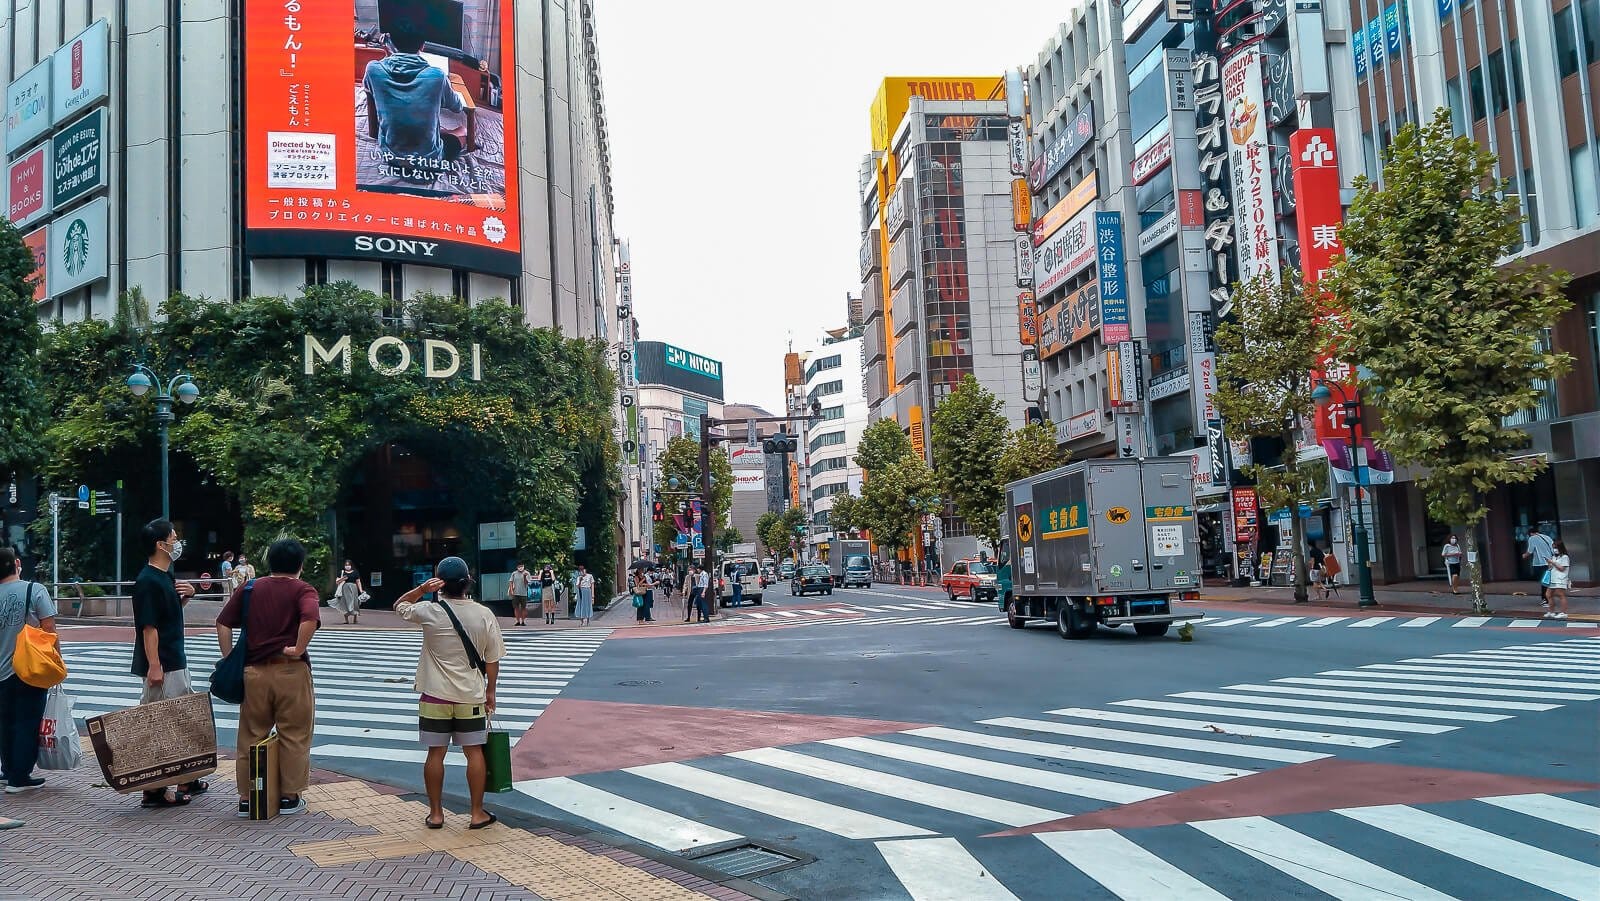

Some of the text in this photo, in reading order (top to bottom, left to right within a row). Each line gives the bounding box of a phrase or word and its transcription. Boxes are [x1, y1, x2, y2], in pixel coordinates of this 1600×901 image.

[1224, 54, 1254, 80] SHIBUYA
[1175, 73, 1186, 108] 山本事務所
[1225, 68, 1247, 92] HONEY
[1226, 82, 1245, 102] TOAST
[305, 142, 315, 150] by
[55, 139, 99, 179] じぶんdeエステ
[370, 151, 470, 175] いやーそれは良いよ
[17, 166, 36, 183] HMV
[23, 184, 29, 192] &
[11, 191, 41, 214] BOOKS
[268, 196, 351, 209] 一般投稿から
[269, 210, 478, 237] プロのクリエイターに選ばれた作品
[355, 236, 439, 257] SONY
[1099, 228, 1119, 295] 渋谷整形
[304, 334, 482, 381] MODI
[668, 348, 686, 367] ニトリ
[689, 357, 719, 377] NITORI
[1202, 371, 1212, 390] 2nd
[911, 422, 923, 445] TOWER
[695, 537, 702, 548] P
